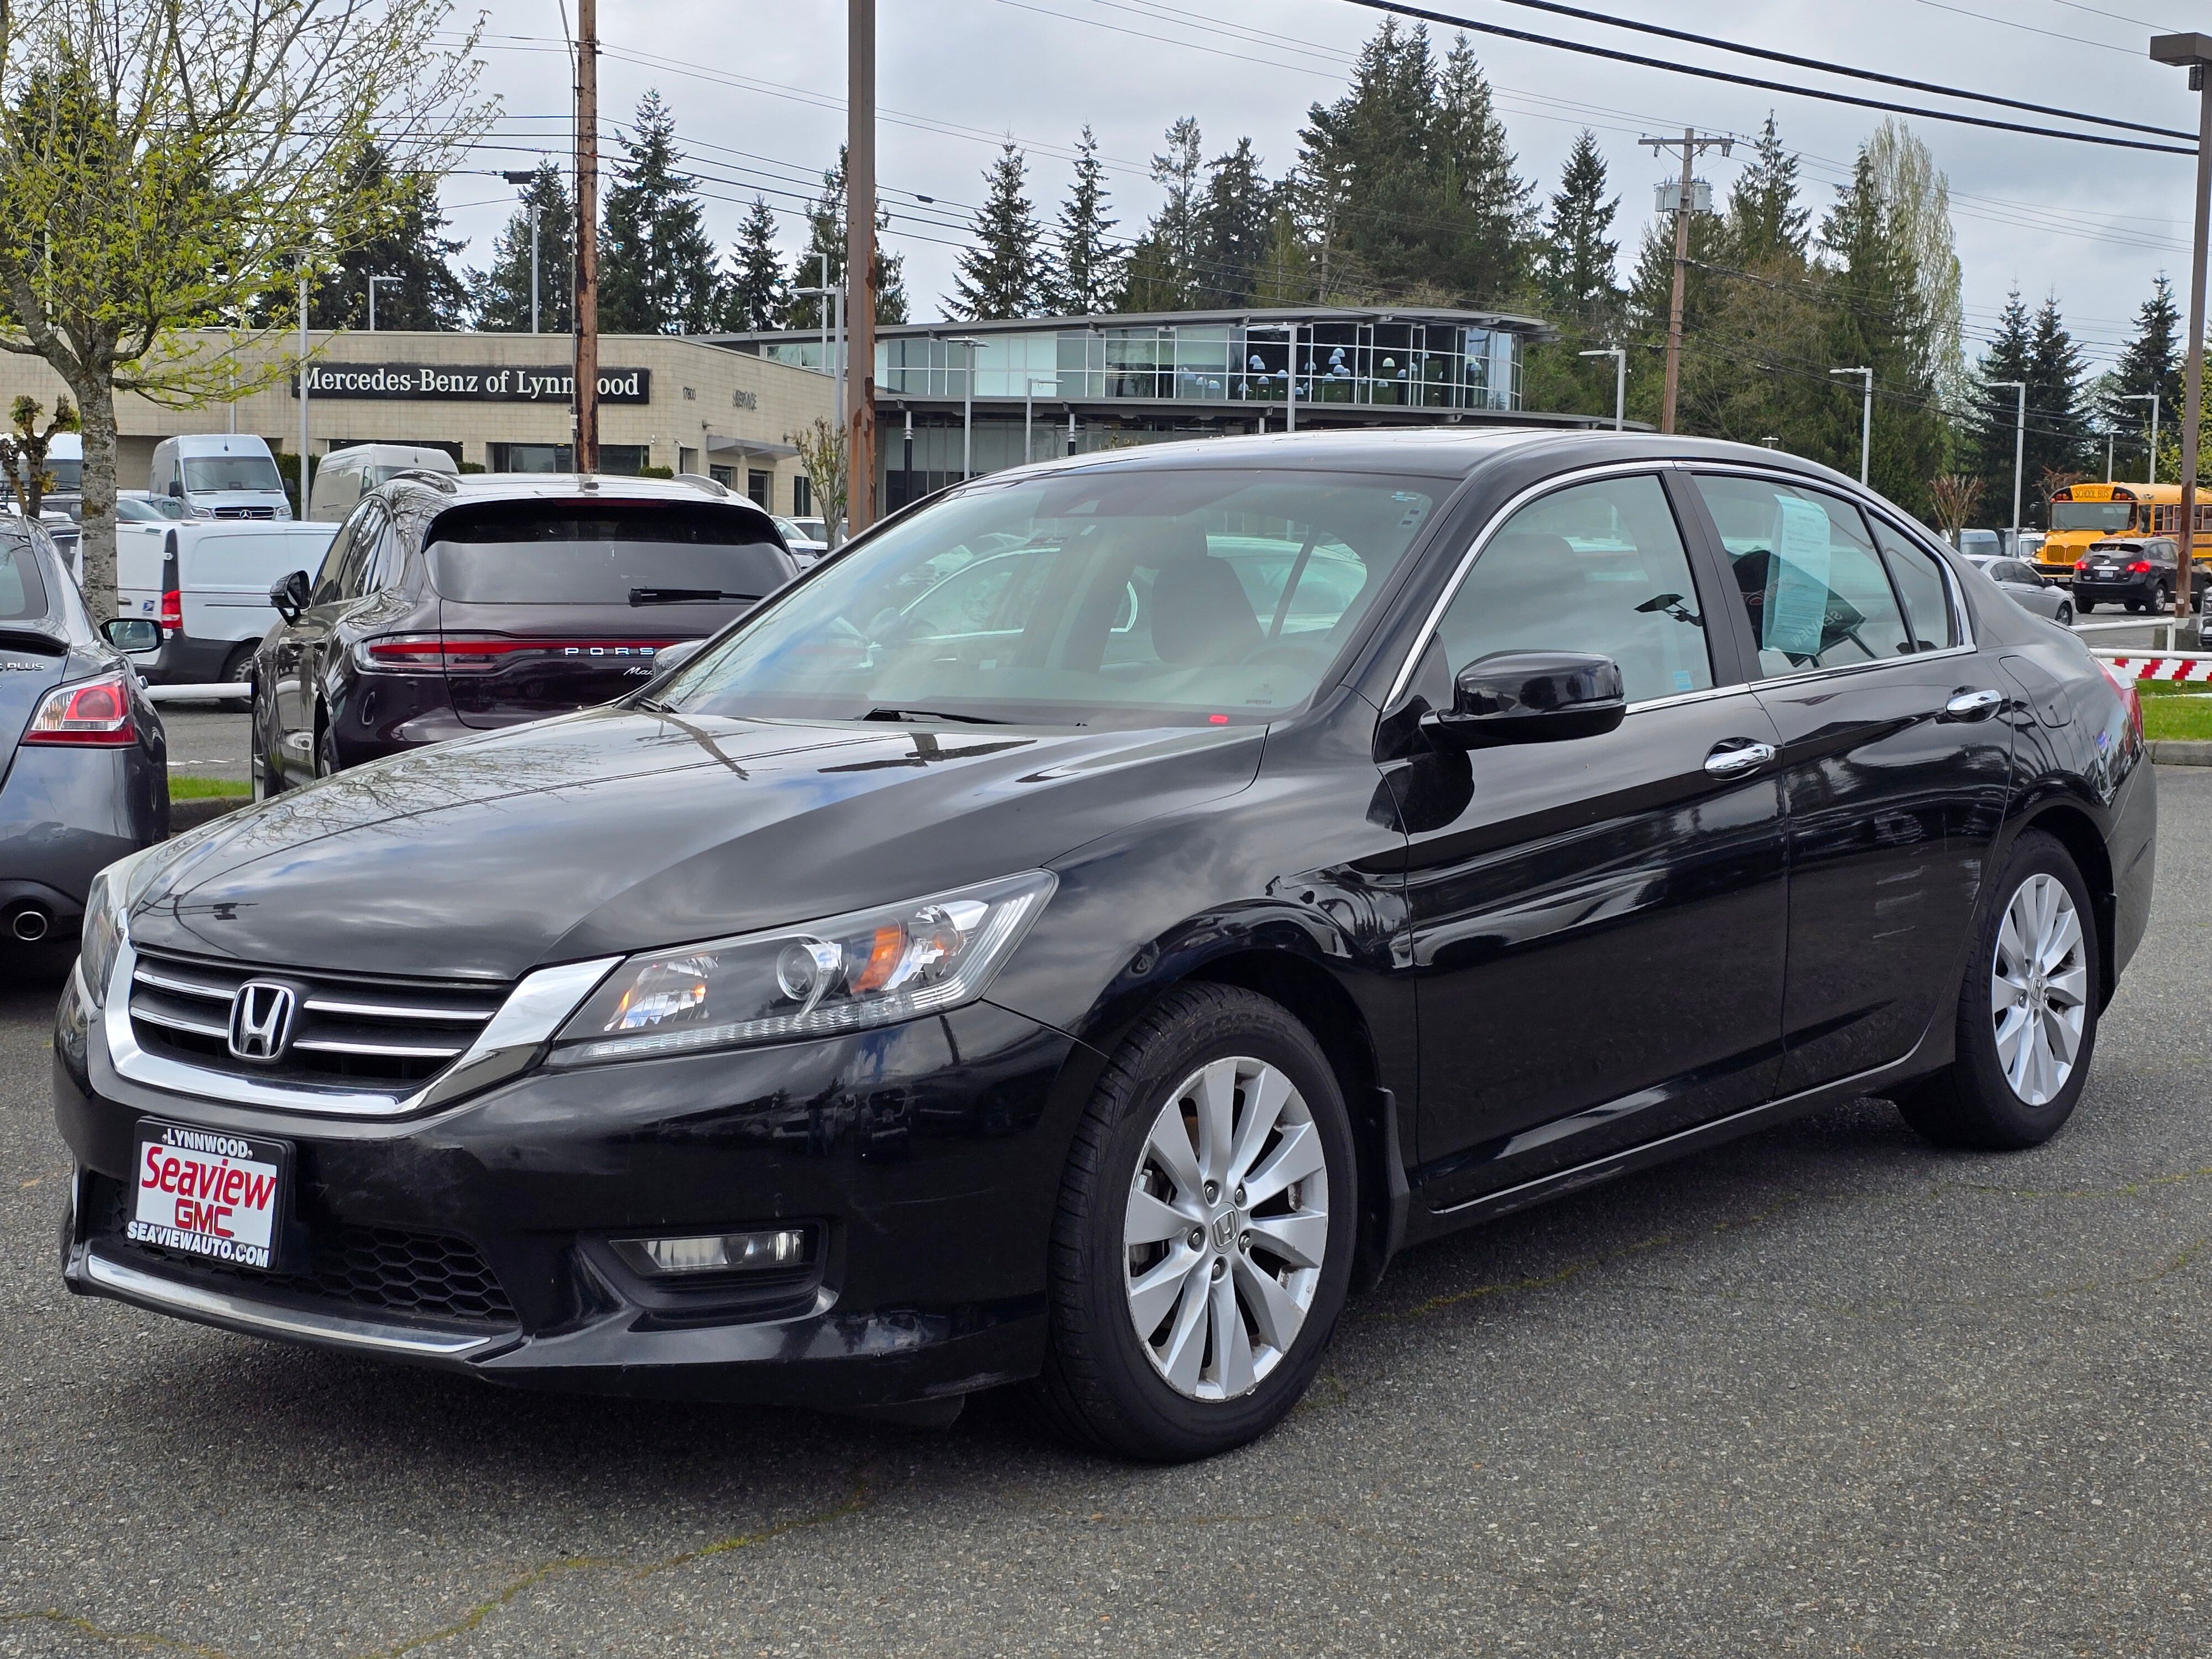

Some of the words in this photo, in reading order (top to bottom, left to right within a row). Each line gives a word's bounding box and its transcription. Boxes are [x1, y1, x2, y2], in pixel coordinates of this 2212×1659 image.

[486, 371, 510, 393] of
[517, 371, 639, 399] Lynnood
[7, 662, 45, 671] PLUS
[167, 1128, 248, 1159] LYNNWOOD
[142, 1146, 277, 1211] Seaview
[175, 1198, 234, 1239] GMC
[127, 1220, 270, 1268] SEAVIEWAUTO.COM
